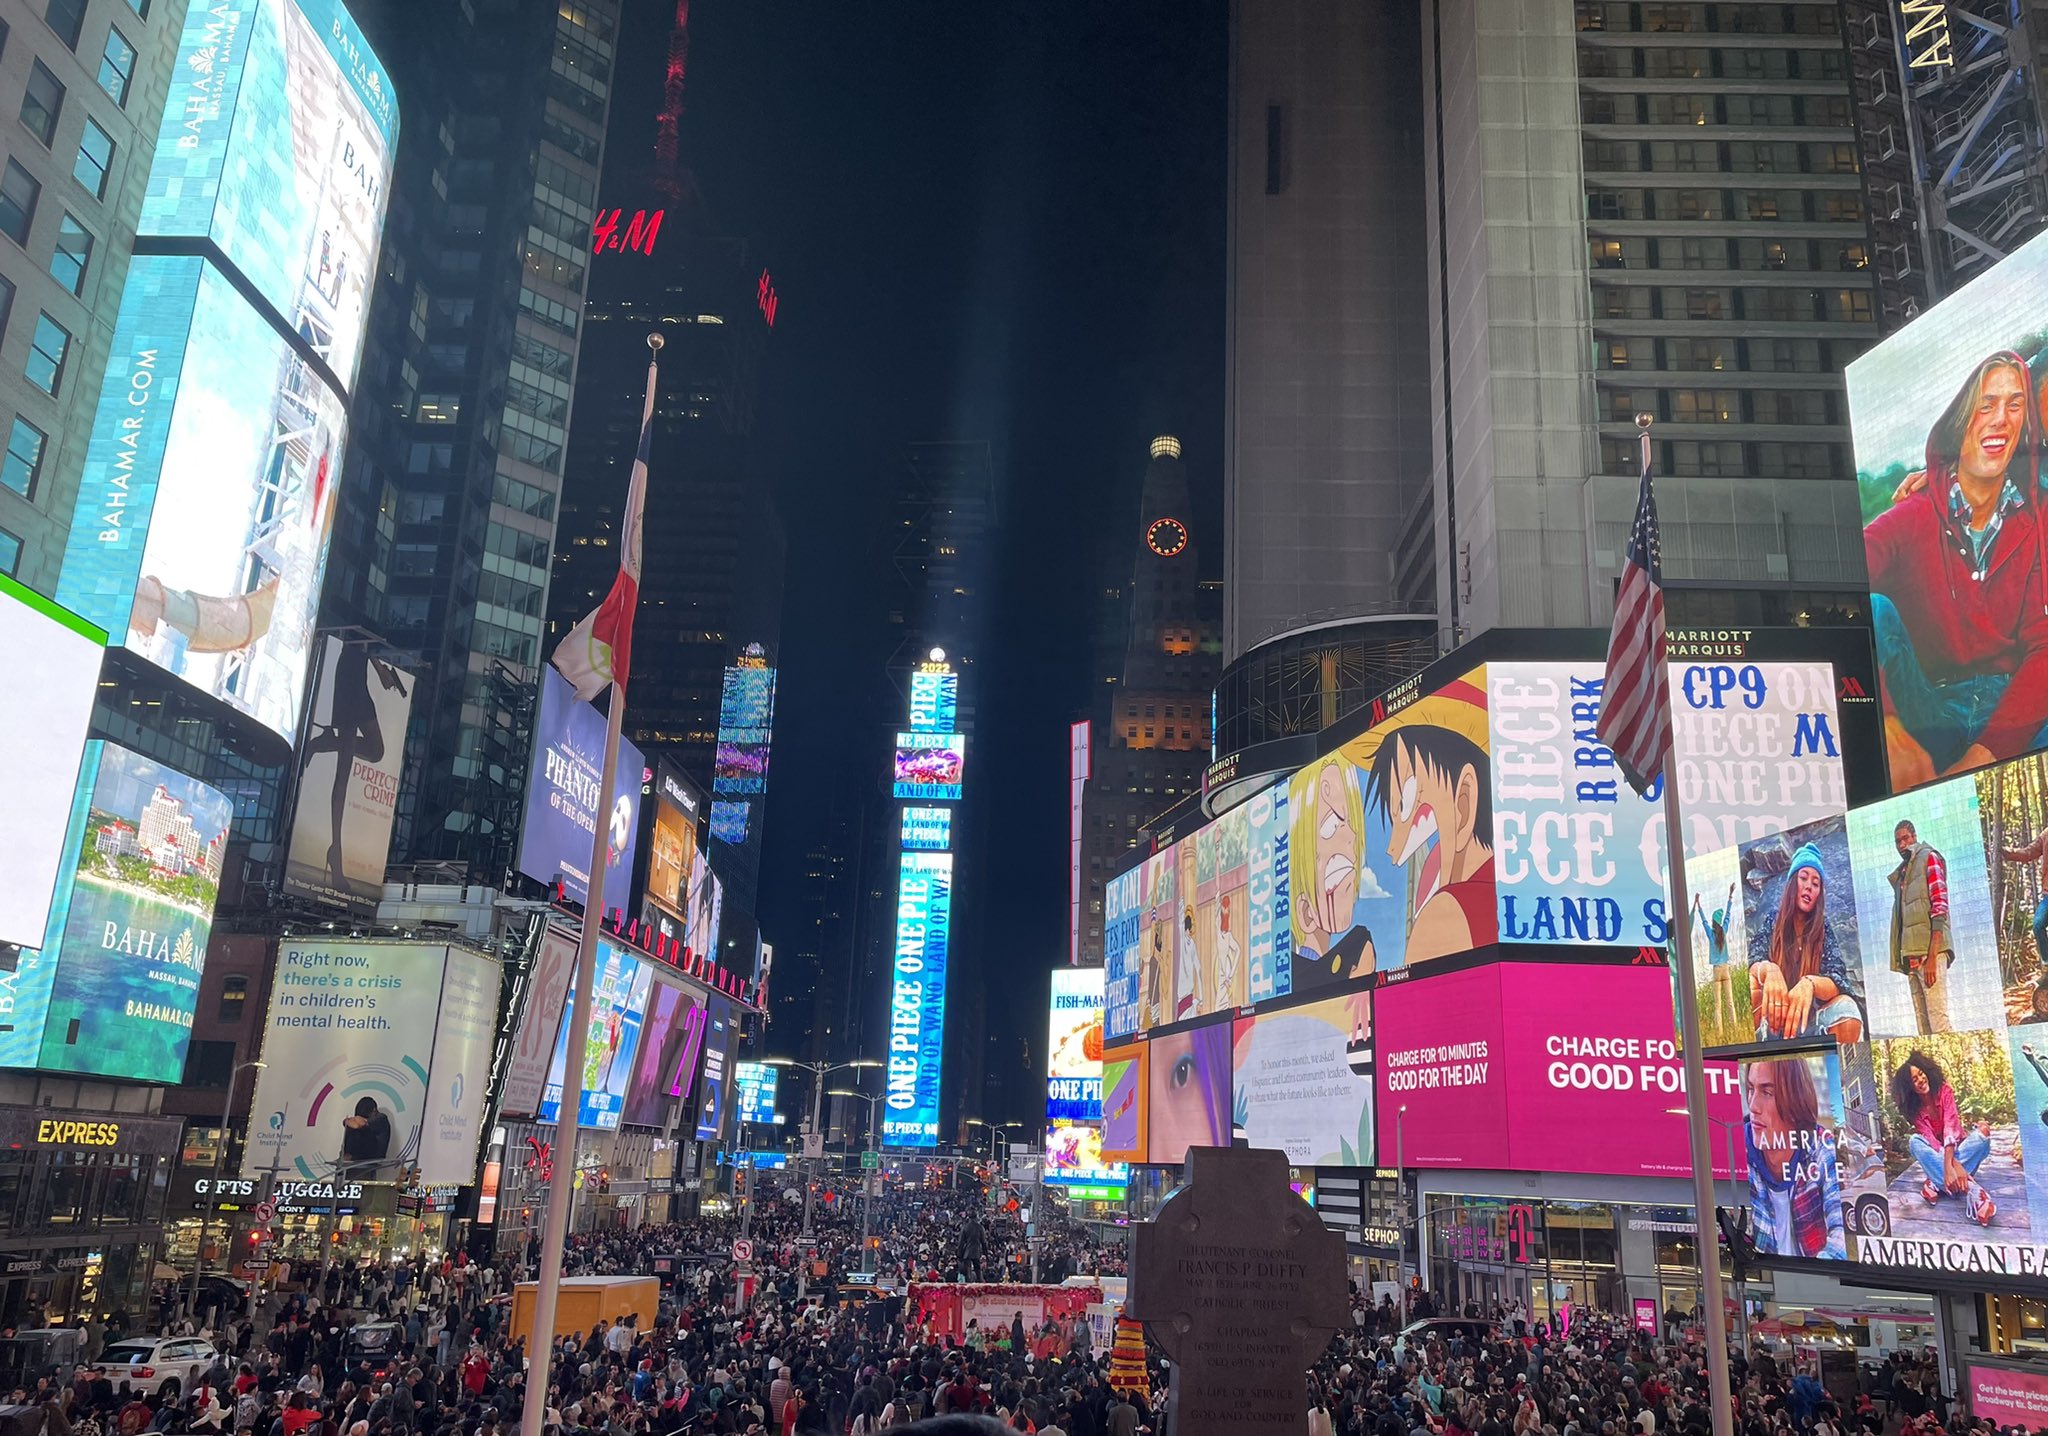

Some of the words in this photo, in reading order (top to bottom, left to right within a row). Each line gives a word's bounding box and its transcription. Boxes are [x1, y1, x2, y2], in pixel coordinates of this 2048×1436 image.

[332, 18, 366, 81] BAHA
[177, 75, 212, 148] BAHA
[593, 208, 665, 256] H&M
[98, 349, 158, 541] BAHAMAR.COM
[1666, 630, 1751, 641] MARRIOTT
[1666, 644, 1743, 655] MARQUIS
[921, 662, 952, 673] 2022
[1387, 674, 1423, 702] MARRIOTT
[1681, 665, 1768, 709] CP9
[1387, 688, 1420, 714] MARQUIS
[939, 713, 956, 731] OF
[353, 762, 399, 792] PERFECT
[1208, 754, 1241, 776] MARRIOTT
[544, 747, 601, 812] PHANTO
[926, 784, 942, 797] OF
[1678, 760, 1769, 806] ONE
[363, 784, 396, 808] CRIME
[551, 792, 562, 809] OF
[562, 800, 576, 820] THE
[911, 821, 930, 829] LAND
[1275, 831, 1290, 922] BARK
[930, 904, 947, 925] OF
[1250, 840, 1273, 1000] PIECE
[101, 920, 170, 963] BAHA
[1121, 915, 1140, 948] FOXY
[287, 951, 330, 968] Right
[334, 955, 370, 969] now,
[896, 922, 926, 974] ONE
[928, 929, 946, 973] LAND
[148, 970, 177, 985] NASSAU,
[657, 932, 746, 999] BROADWAY
[284, 972, 340, 988] there's
[344, 977, 353, 987] a
[358, 975, 402, 989] crisis
[280, 992, 294, 1006] in
[299, 993, 376, 1009] children's
[923, 982, 943, 1032] WANO
[126, 1000, 195, 1029] BAHAMAR.COM
[276, 1014, 331, 1028] mental
[337, 1015, 391, 1030] health.
[889, 980, 922, 1054] PIECE
[922, 1037, 940, 1058] OF
[1388, 1050, 1419, 1068] CHARGE
[1420, 1047, 1437, 1063] FOR
[1438, 1046, 1447, 1062] 10
[1448, 1041, 1488, 1060] MINUTES
[1546, 1035, 1640, 1060] CHARGE
[1645, 1039, 1679, 1061] FO
[887, 1056, 918, 1110] ONE
[919, 1062, 938, 1109] LAND
[1389, 1069, 1417, 1091] GOOD
[1419, 1067, 1440, 1089] FOR
[1441, 1064, 1463, 1087] THE
[1463, 1062, 1488, 1085] DAY
[1548, 1062, 1633, 1090] GOOD
[1050, 1081, 1079, 1100] ONE
[37, 1120, 119, 1146] EXPRESS
[257, 1131, 274, 1140] Child
[896, 1122, 922, 1134] PIECE
[1759, 1129, 1849, 1150] AMERICA
[1783, 1162, 1844, 1183] EAGLE
[195, 1179, 253, 1196] GFTS
[7, 1260, 42, 1273] EXPRESS
[1178, 1259, 1238, 1275] FRANCIS
[1258, 1263, 1307, 1279] DUFFY
[1861, 1238, 2006, 1276] AMERICAN
[1217, 1327, 1268, 1337] CHAPLAIN
[1246, 1343, 1291, 1355] INFANTRY
[1232, 1388, 1246, 1399] OF
[1250, 1388, 1293, 1400] SERVICE
[1976, 1393, 2015, 1409] Broadway
[1979, 1384, 1994, 1393] Get
[1995, 1386, 2008, 1395] the
[2009, 1388, 2025, 1398] best
[1190, 1409, 1216, 1420] GOD
[1220, 1410, 1242, 1421] AND
[1246, 1411, 1297, 1423] COUNTRY
